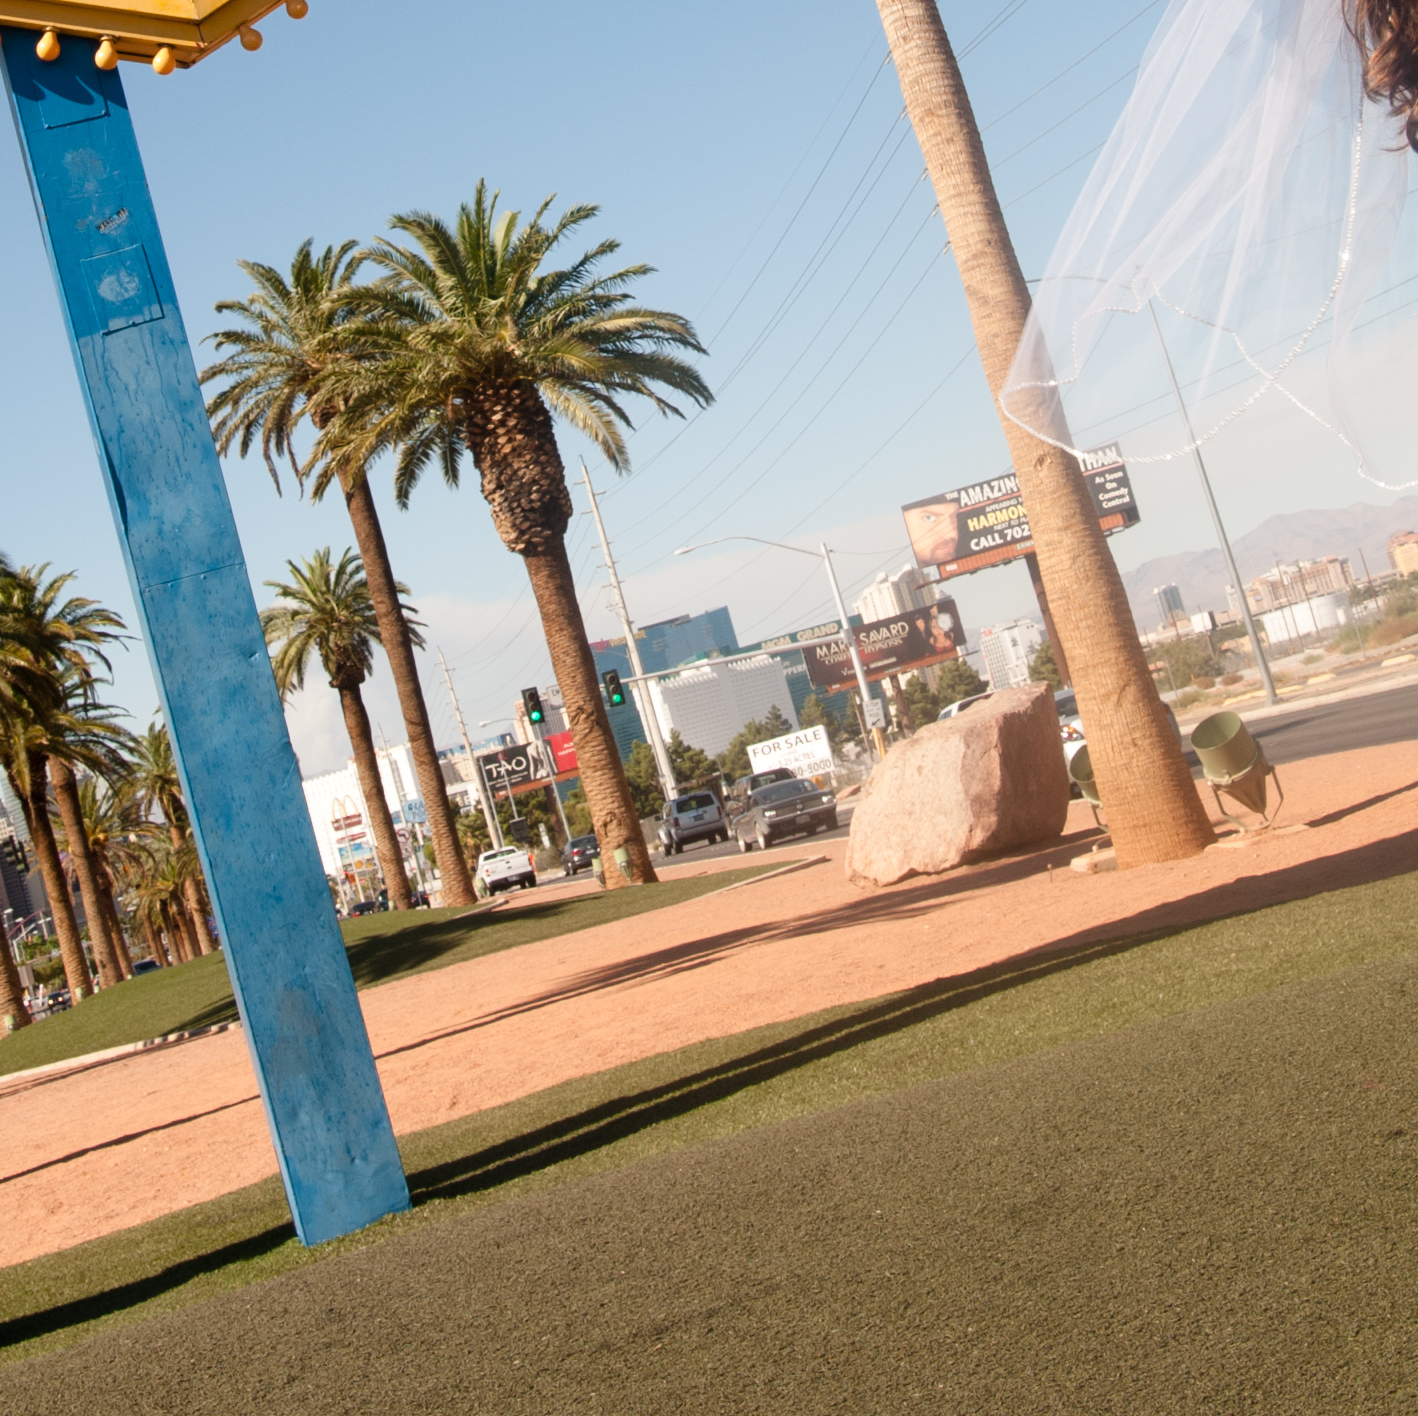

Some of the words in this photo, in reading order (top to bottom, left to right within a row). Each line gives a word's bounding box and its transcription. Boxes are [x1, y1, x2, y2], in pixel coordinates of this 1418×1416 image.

[1095, 476, 1105, 484] As
[1105, 471, 1123, 481] Seen
[1099, 487, 1128, 500] Comedy
[1102, 494, 1130, 508] Central
[970, 533, 1004, 551] CALL
[797, 622, 838, 642] GRAND
[859, 622, 909, 646] SAVARD
[752, 741, 782, 758] FOR
[784, 729, 822, 749] SALE
[485, 756, 527, 778] TAO
